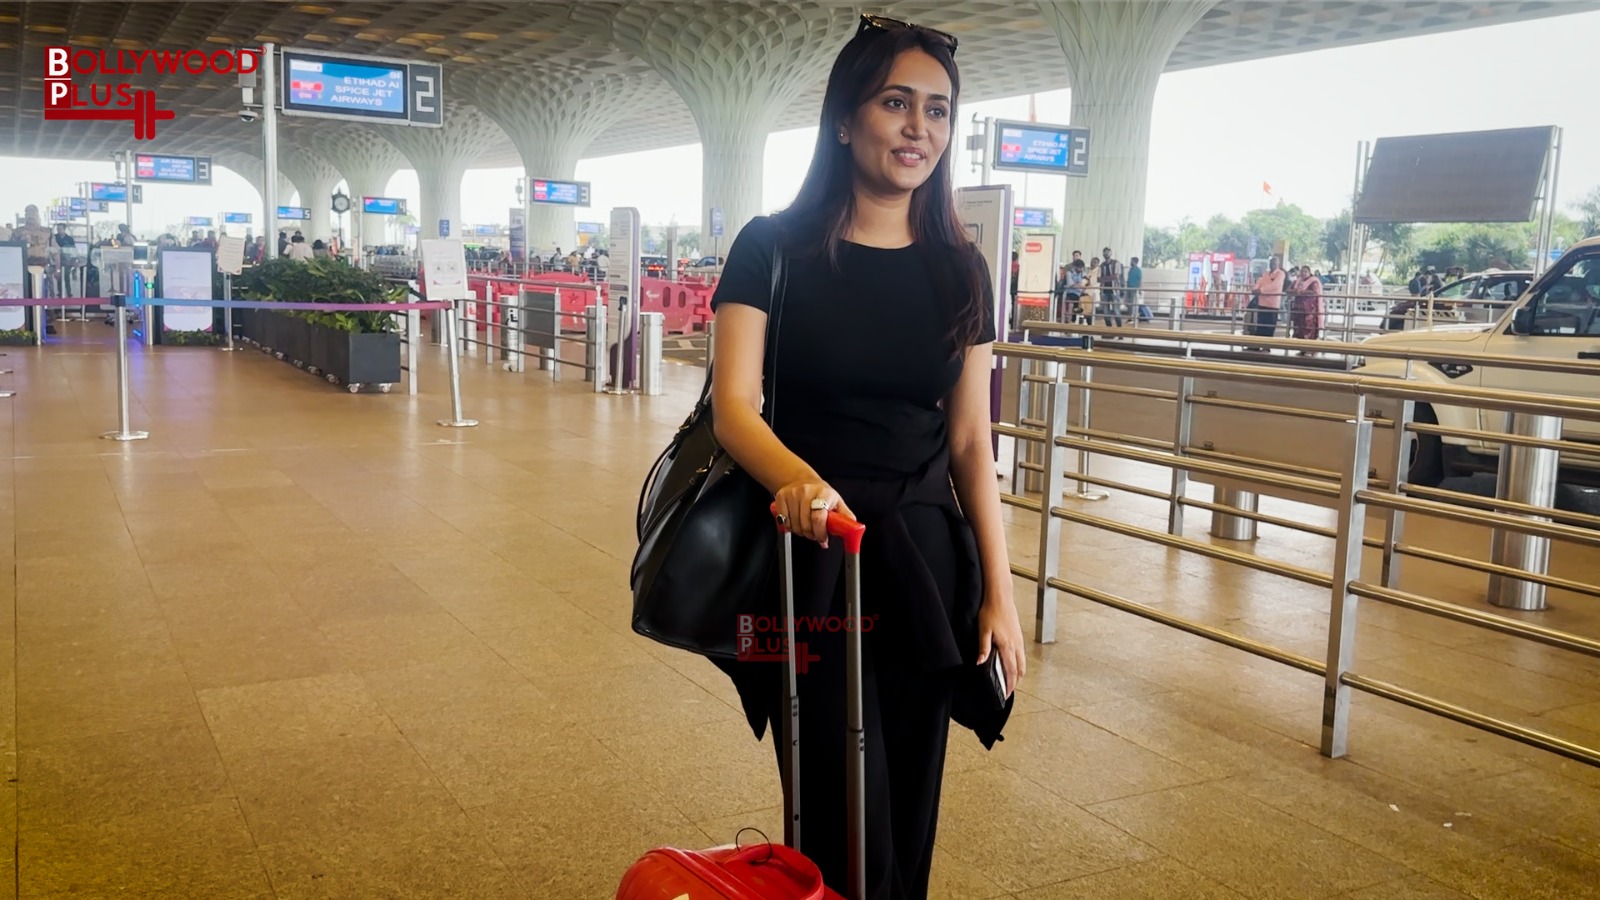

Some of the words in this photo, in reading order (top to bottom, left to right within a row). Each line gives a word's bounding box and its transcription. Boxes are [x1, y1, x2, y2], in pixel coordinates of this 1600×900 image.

[343, 76, 386, 88] ETIHAD
[334, 85, 370, 96] SPICE
[372, 89, 393, 98] JET
[415, 75, 435, 112] 2
[330, 95, 383, 107] AIRWAYS
[1073, 137, 1086, 165] 2
[199, 162, 209, 179] 3
[581, 186, 589, 202] 3
